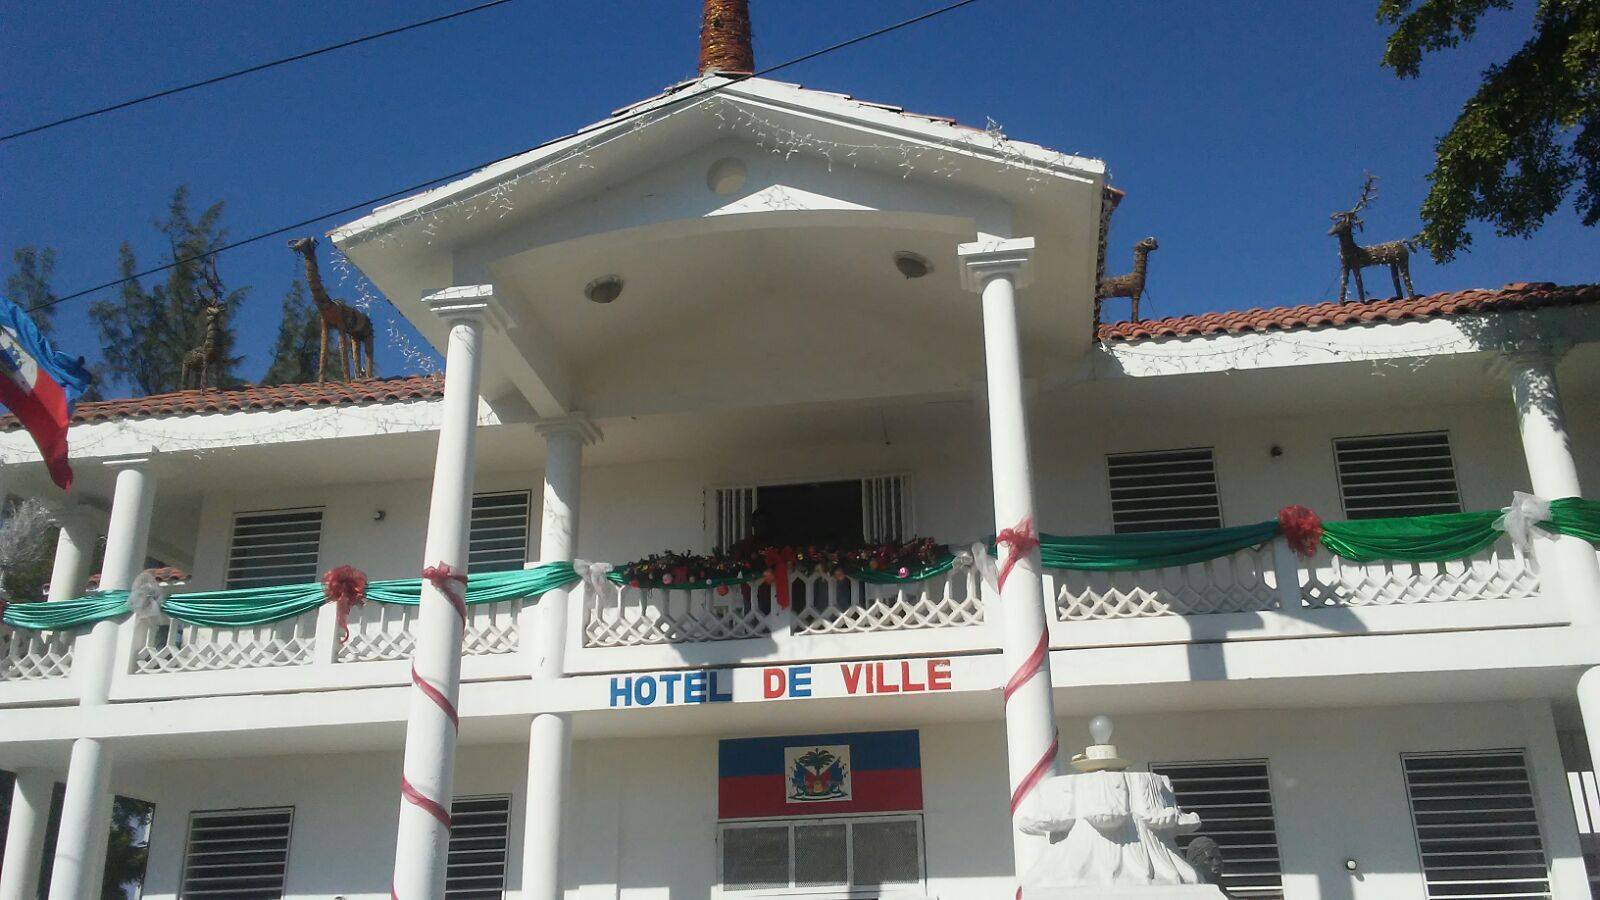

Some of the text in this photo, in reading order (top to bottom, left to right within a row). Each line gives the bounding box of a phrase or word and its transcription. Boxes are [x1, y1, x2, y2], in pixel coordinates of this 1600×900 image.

[610, 659, 951, 707] HOTEL DE VILLE
